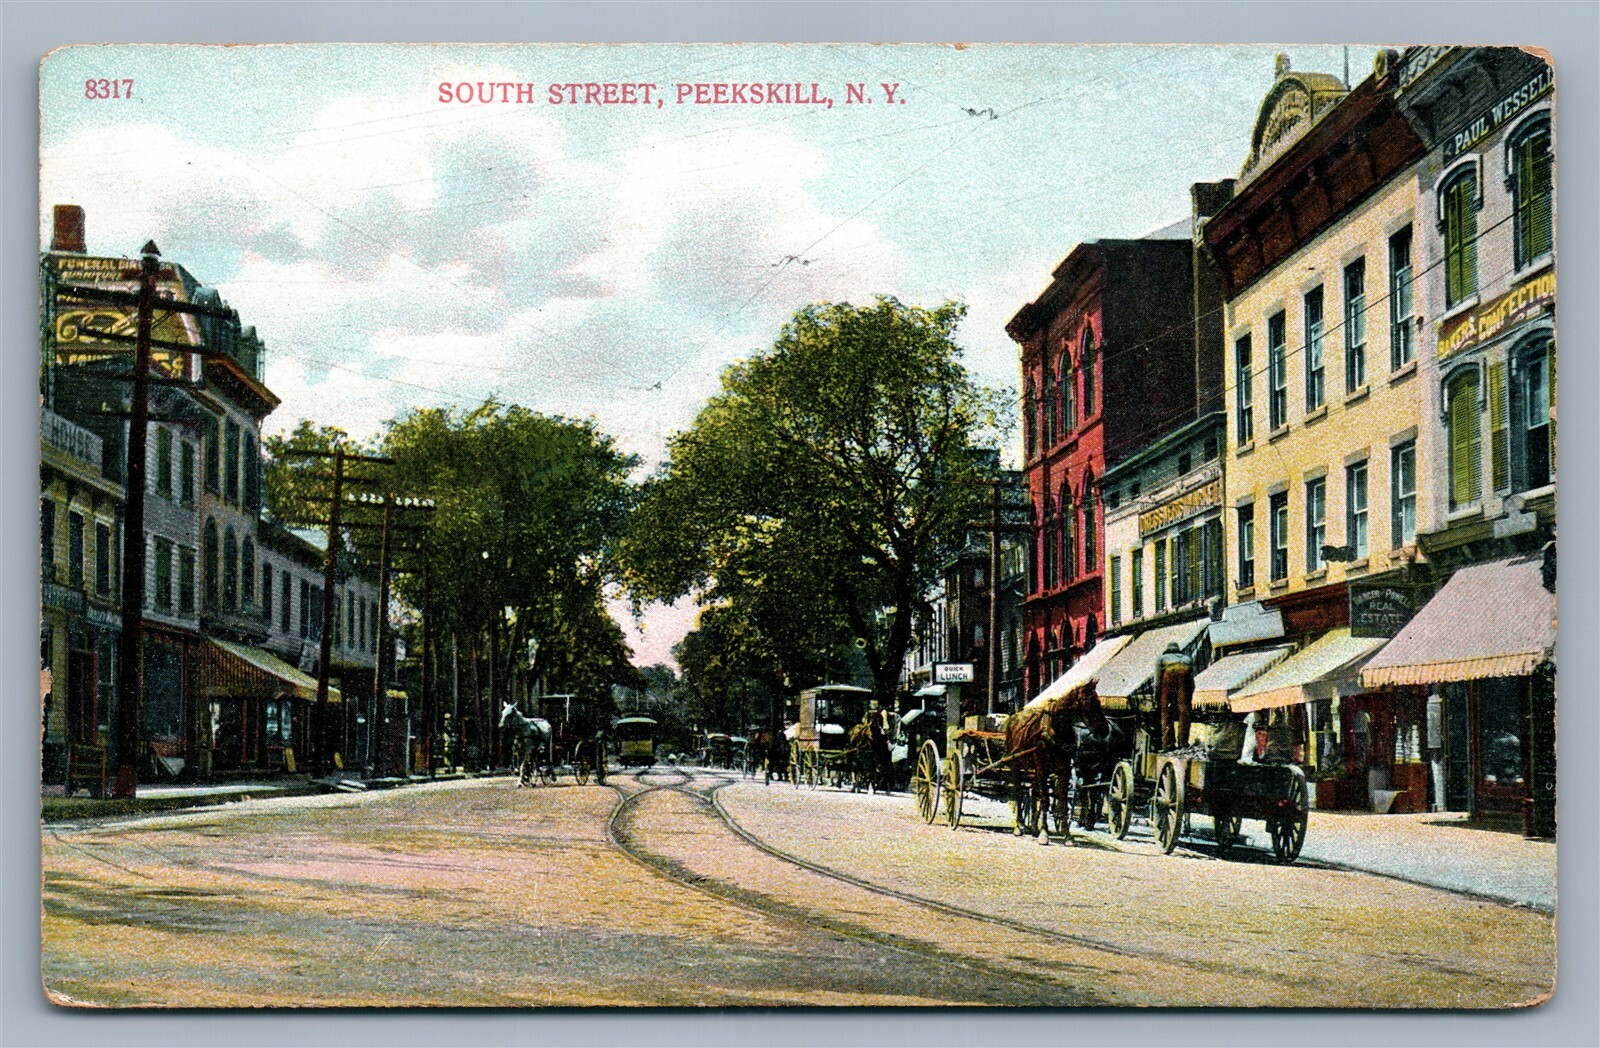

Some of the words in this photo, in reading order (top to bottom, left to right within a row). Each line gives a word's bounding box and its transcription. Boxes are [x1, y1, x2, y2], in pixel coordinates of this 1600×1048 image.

[1454, 117, 1490, 155] PAUL
[58, 258, 117, 271] FUNERAL
[1360, 613, 1404, 624] ESTATE
